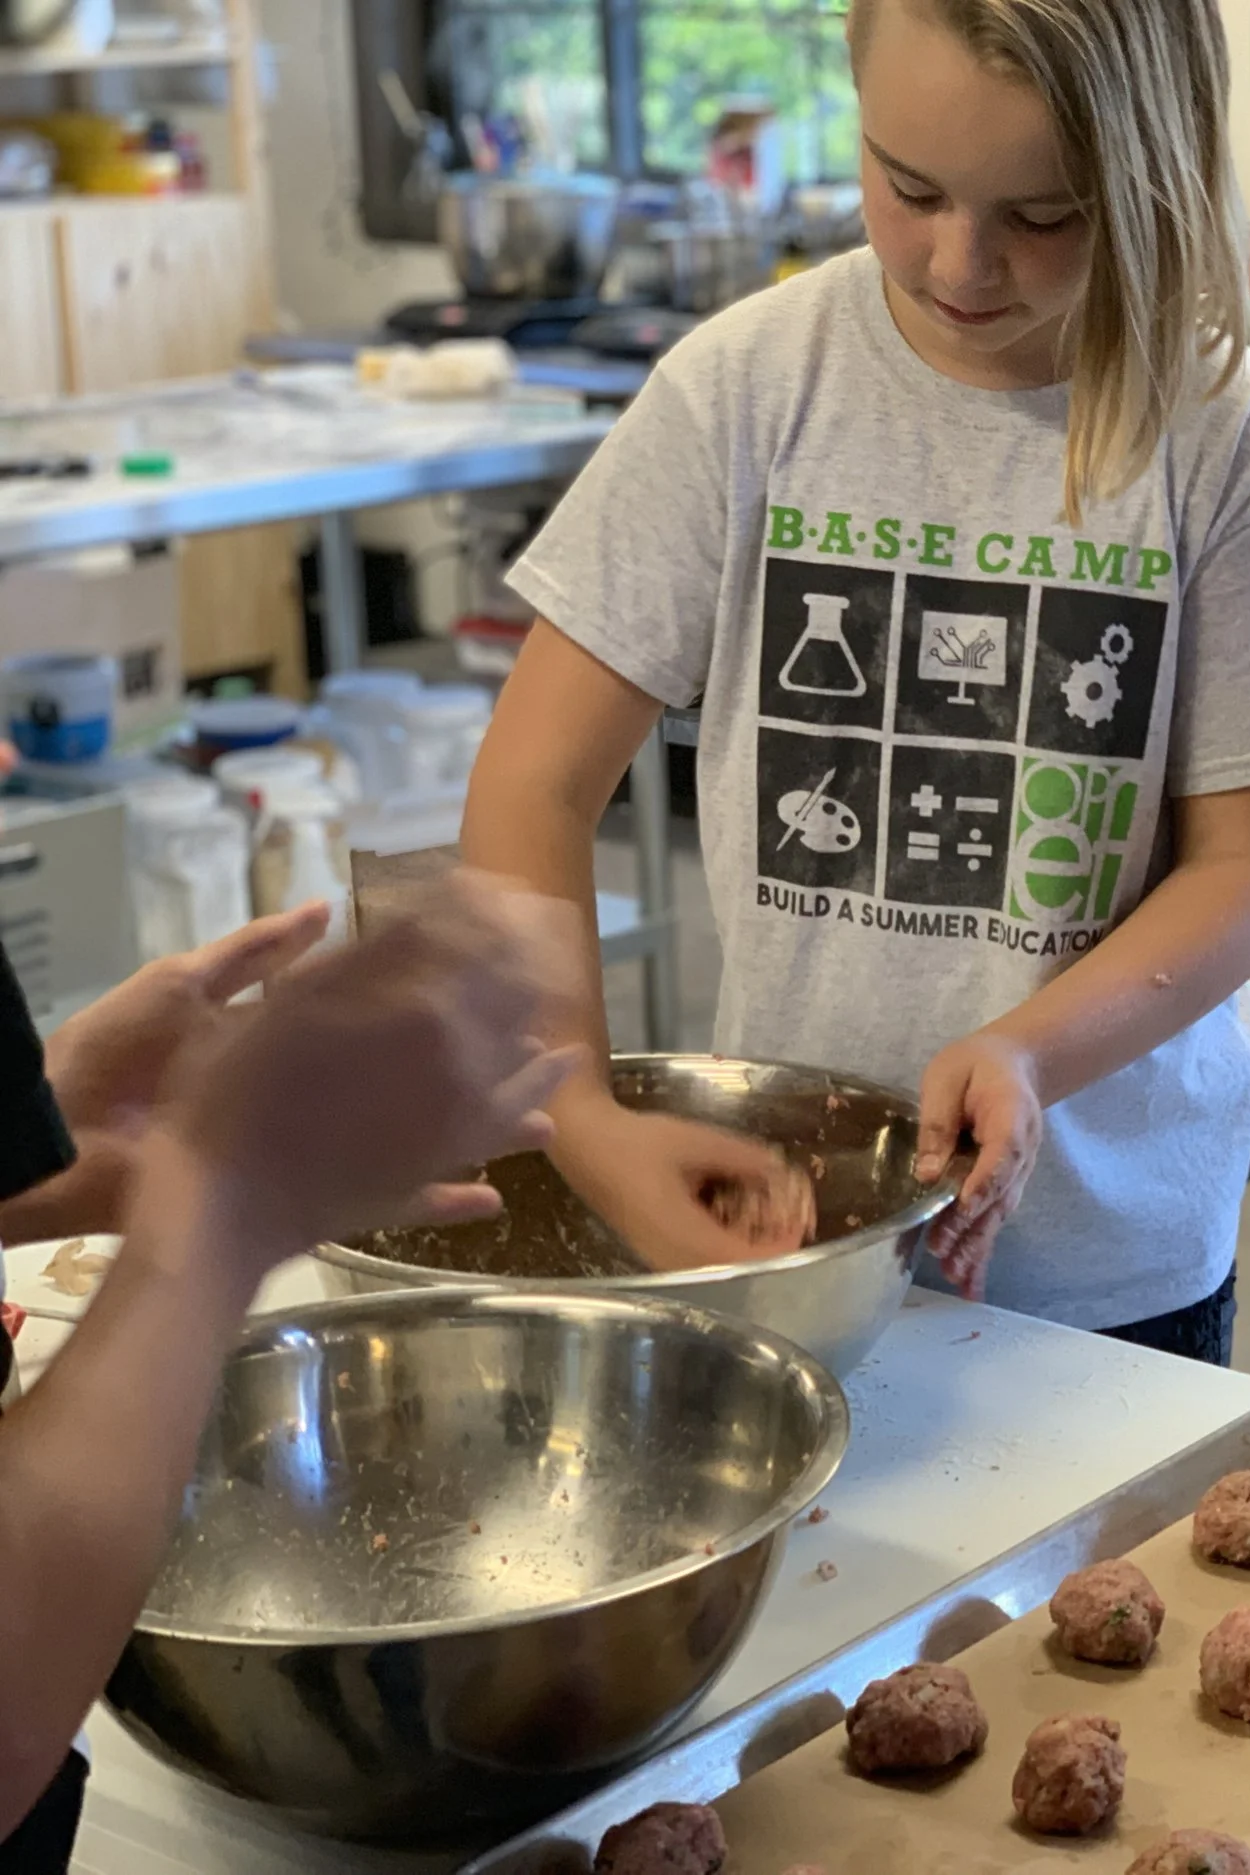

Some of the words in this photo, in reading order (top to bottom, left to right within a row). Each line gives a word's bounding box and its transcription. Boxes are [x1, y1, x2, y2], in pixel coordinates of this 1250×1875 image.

[976, 532, 1172, 590] CAMP
[756, 883, 831, 917] BUILD
[837, 898, 854, 922] A
[860, 902, 979, 940] SUMMER
